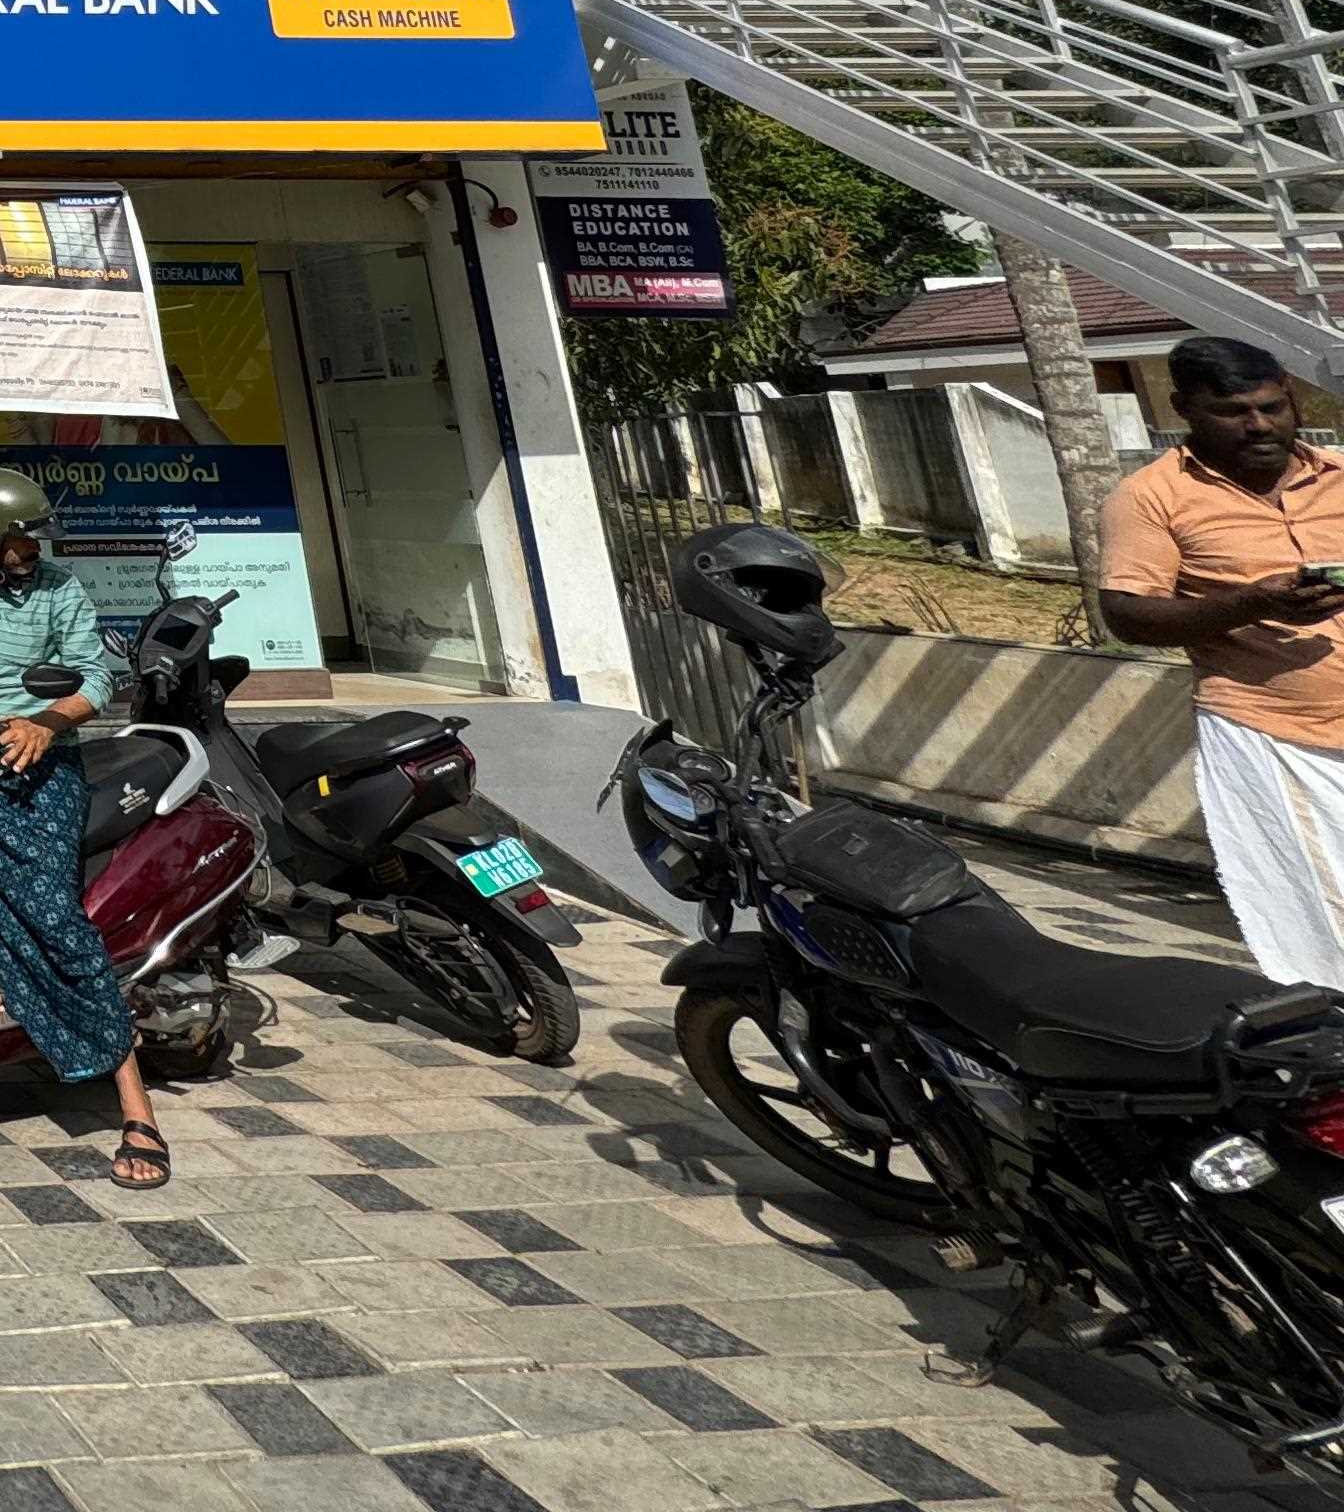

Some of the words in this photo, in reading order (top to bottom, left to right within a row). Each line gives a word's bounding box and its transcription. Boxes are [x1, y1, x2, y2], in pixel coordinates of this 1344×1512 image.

[323, 9, 372, 28] CASH
[378, 9, 461, 29] MACHINE
[603, 111, 680, 138] LITE
[608, 140, 668, 155] BROAD
[568, 203, 671, 218] DISTANCE
[572, 221, 690, 236] EDUCATION
[639, 242, 674, 254] B.Com
[153, 266, 200, 281] EDERAL
[202, 266, 238, 281] BANK
[567, 274, 634, 296] MBA
[113, 453, 221, 485] വായ്പ
